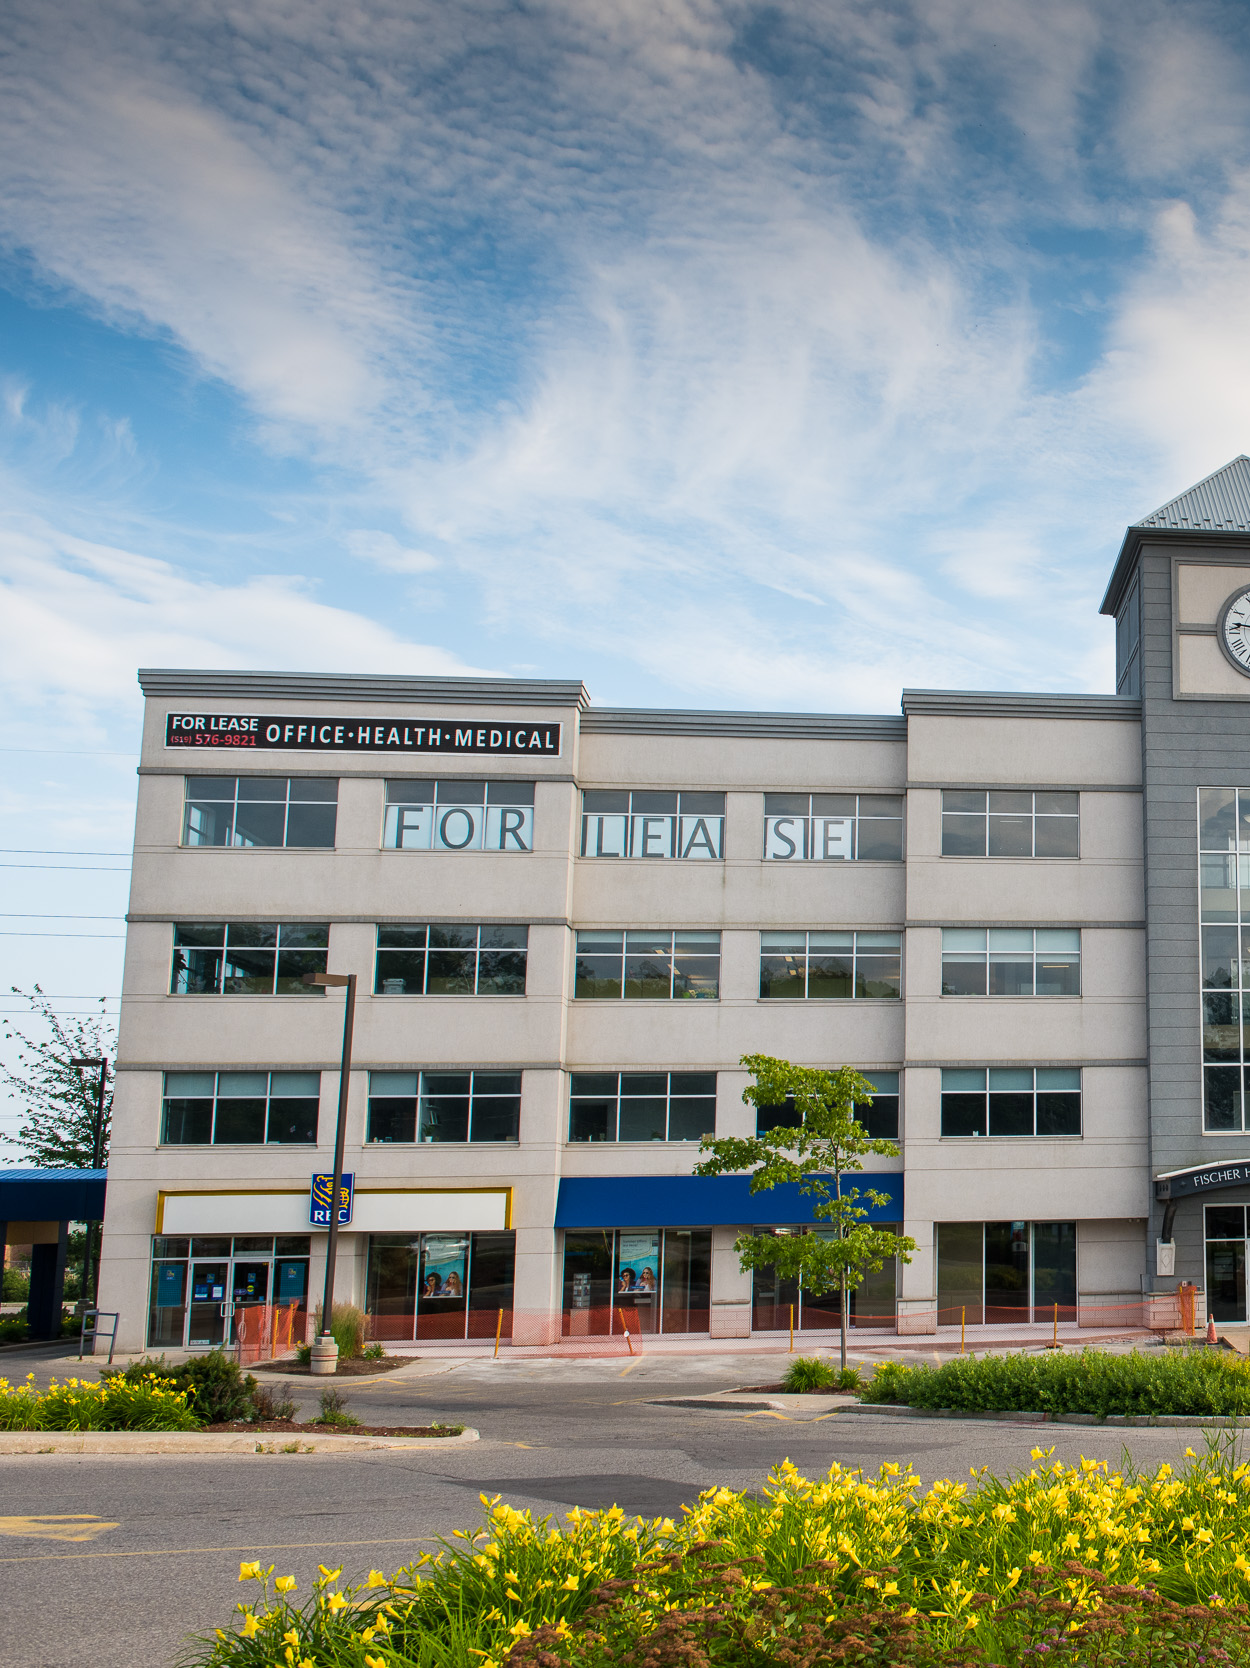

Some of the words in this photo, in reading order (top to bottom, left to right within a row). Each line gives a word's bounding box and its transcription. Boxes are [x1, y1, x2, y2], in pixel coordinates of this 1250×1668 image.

[172, 716, 206, 730] FOR
[211, 717, 259, 731] LEASE
[170, 736, 192, 744] (519)
[194, 734, 257, 746] 576-9821
[266, 724, 345, 744] OFFICE
[357, 726, 441, 746] HEALTH
[455, 729, 554, 749] MEDICAL
[395, 806, 529, 850] FOR
[1193, 1169, 1241, 1187] FISCHER
